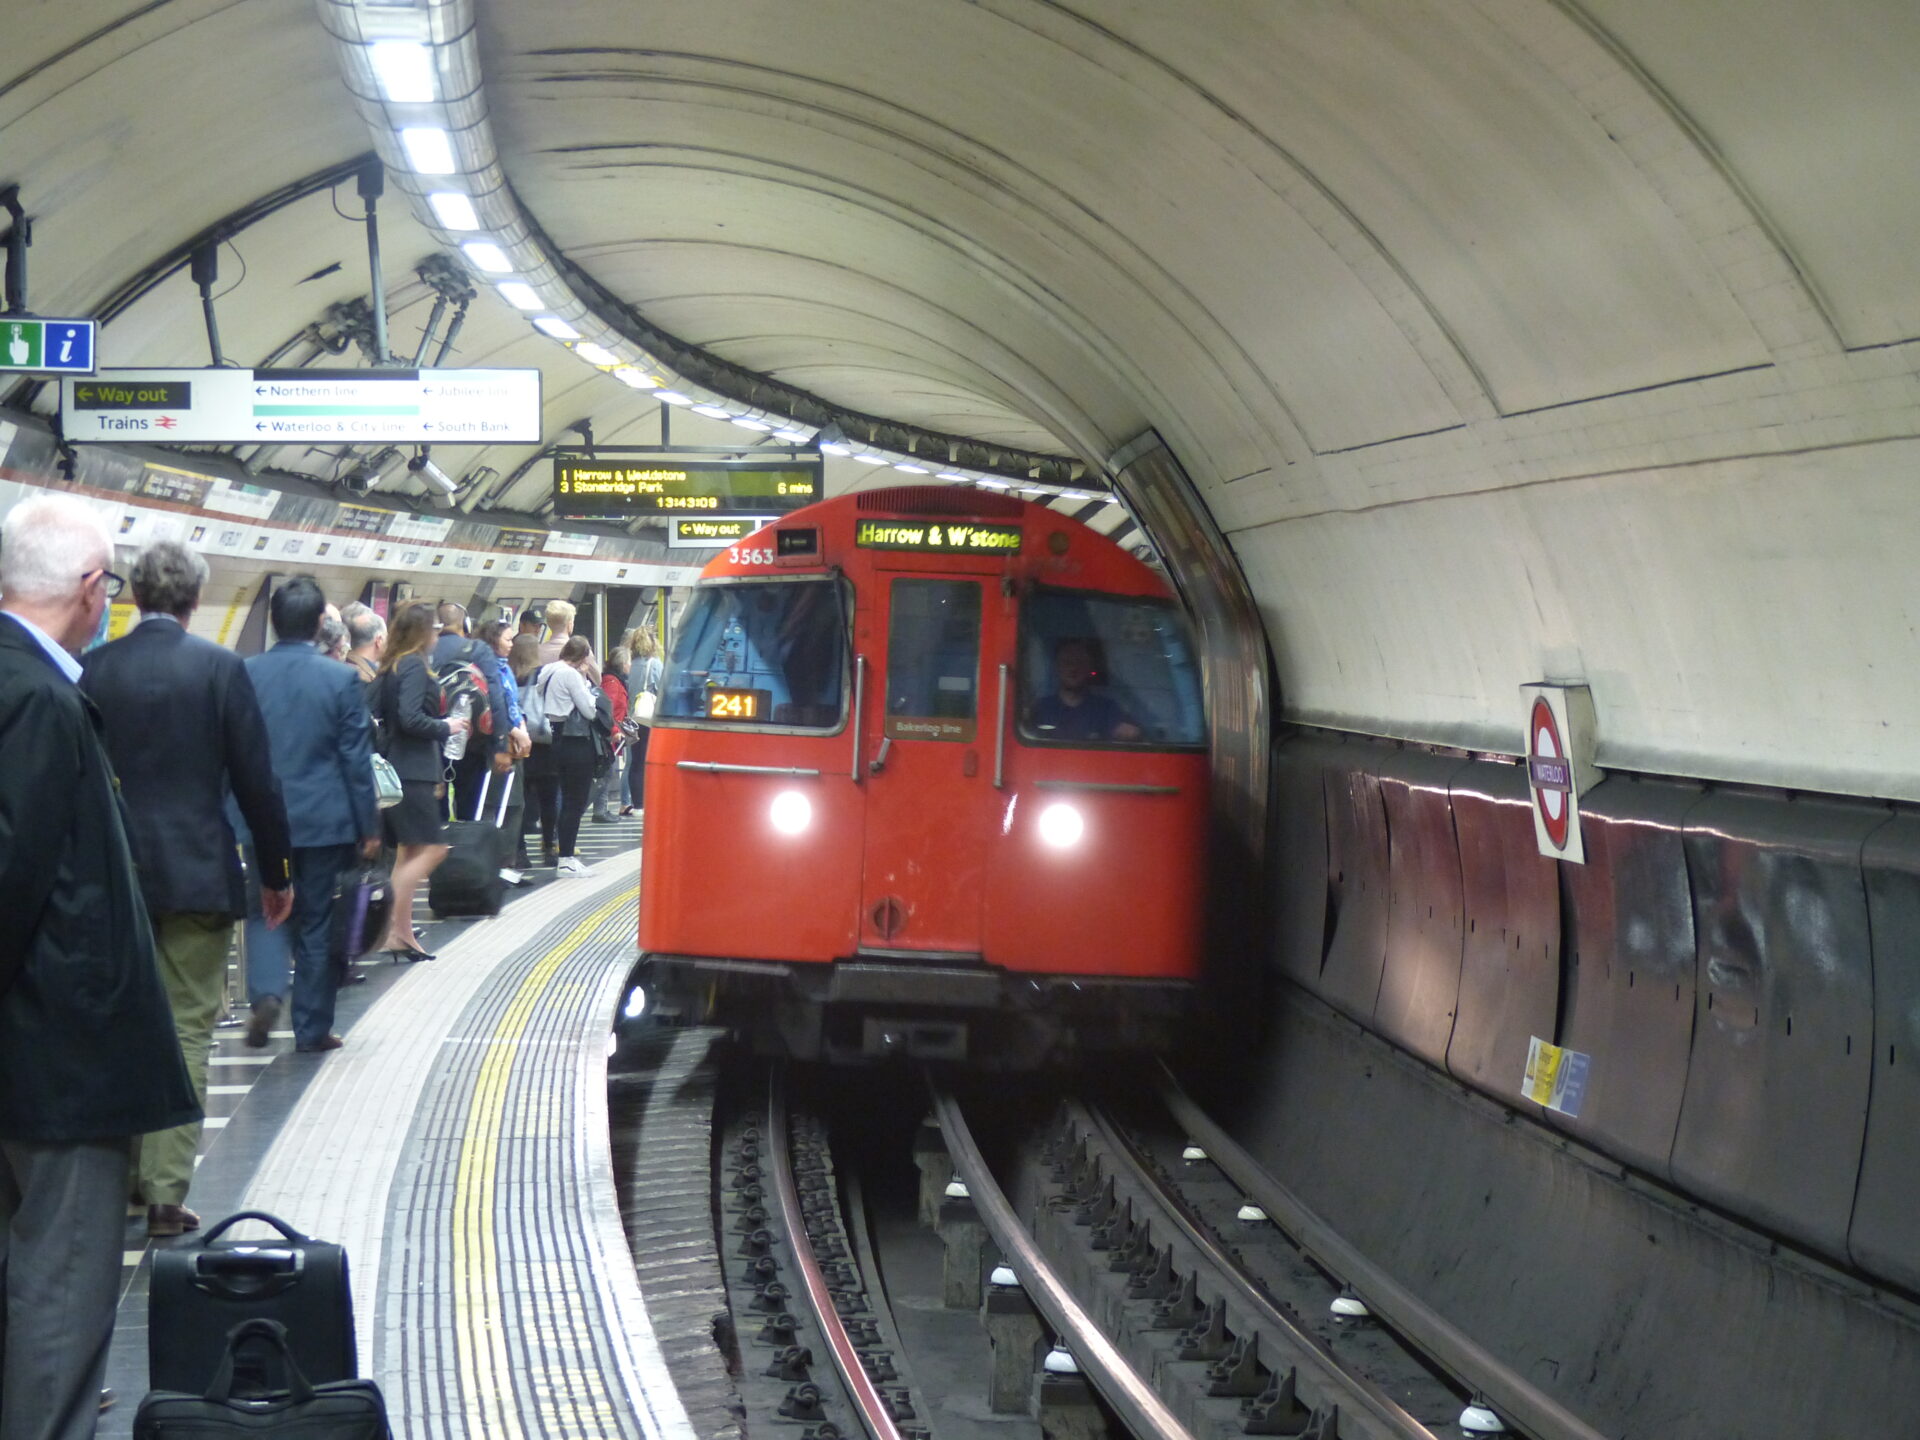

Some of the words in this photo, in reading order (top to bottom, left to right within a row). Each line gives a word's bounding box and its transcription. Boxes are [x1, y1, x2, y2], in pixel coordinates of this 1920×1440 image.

[98, 388, 133, 405] Way
[137, 388, 168, 402] out
[270, 386, 331, 396] Northern
[335, 386, 358, 396] line
[98, 415, 149, 430] Trains
[271, 421, 332, 432] Waterloo
[337, 421, 345, 432] &
[351, 421, 377, 433] City
[382, 421, 406, 432] line
[438, 421, 476, 432] South
[481, 421, 511, 432] Bank
[562, 469, 567, 481] 1
[573, 469, 612, 481] Harrow
[615, 470, 624, 481] &
[626, 469, 687, 481] Wealdstone
[560, 481, 569, 493] 3
[573, 481, 636, 494] Stonebridge
[638, 481, 664, 494] Park
[777, 483, 786, 494] 6
[789, 483, 813, 495] mins
[692, 523, 717, 537] Way
[719, 523, 740, 535] out
[861, 523, 923, 544] Harrow
[927, 525, 942, 545] &
[948, 526, 1020, 548] W'stone
[729, 547, 774, 565] 3563
[712, 694, 753, 717] 241
[896, 721, 942, 733] Bakerloo
[944, 722, 962, 733] line
[1537, 764, 1564, 784] WATERLOO
